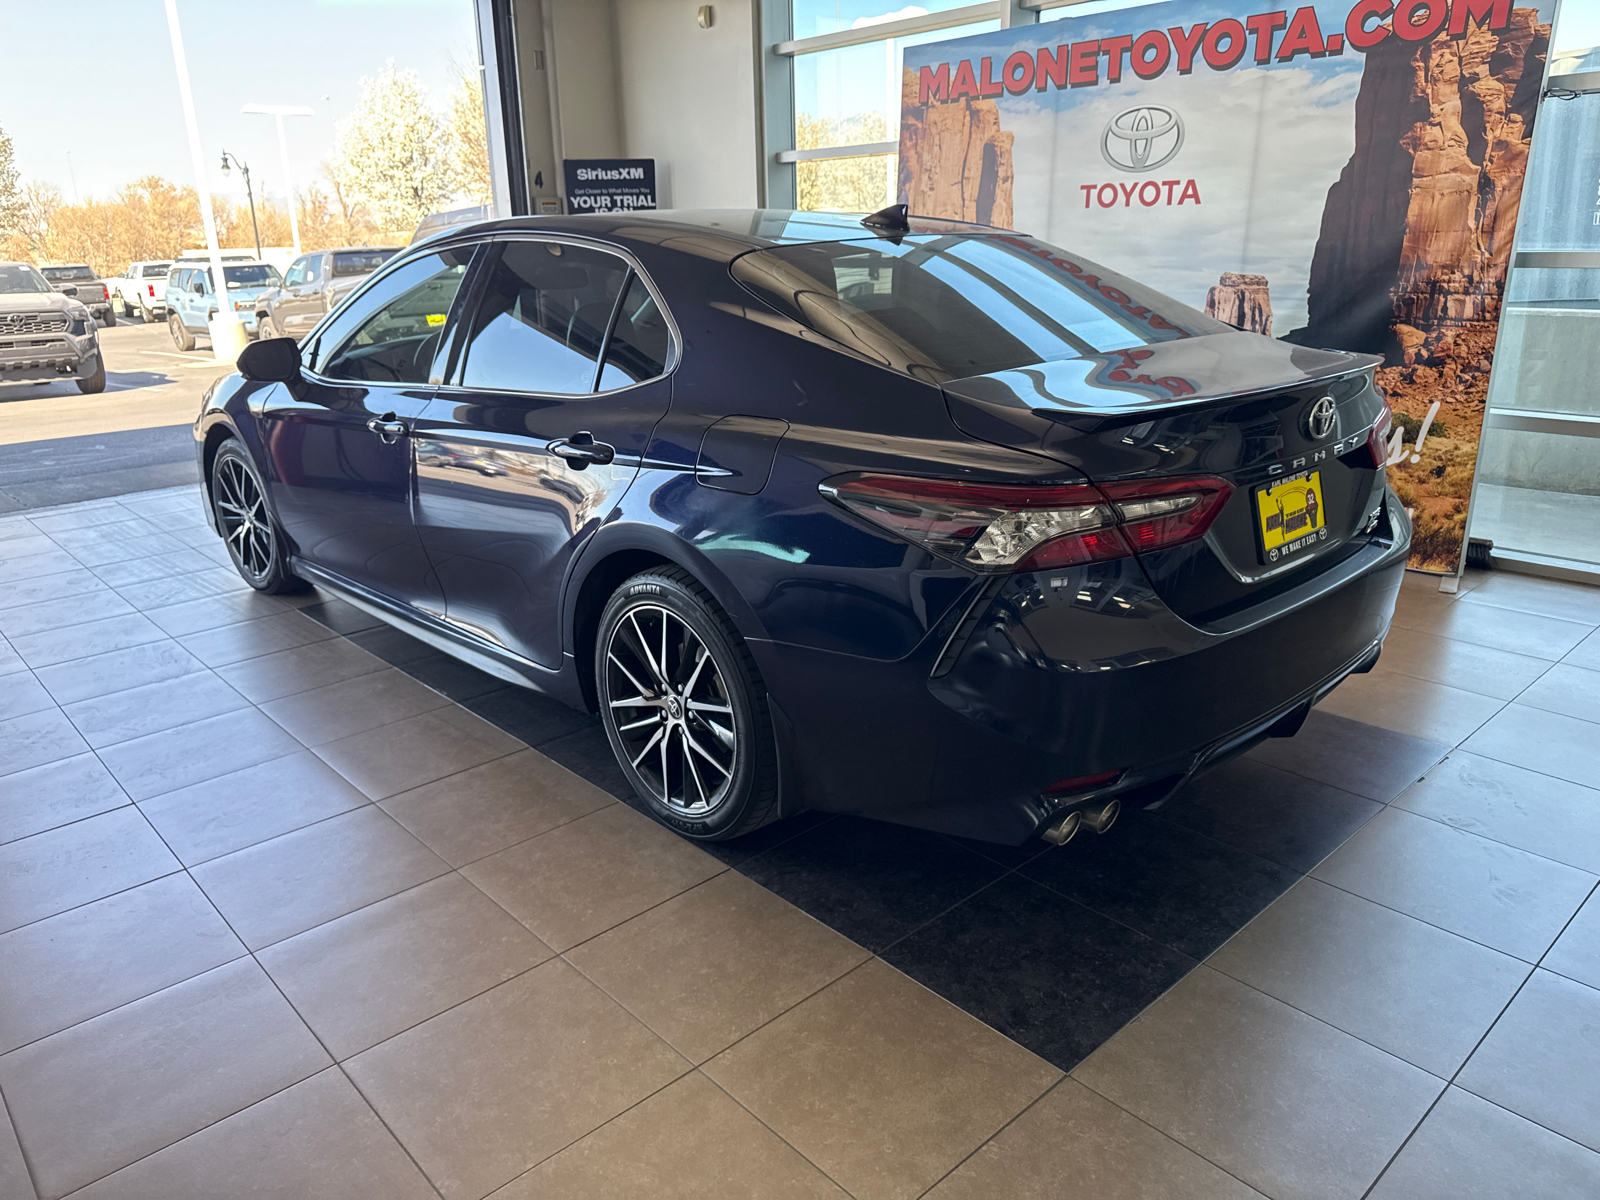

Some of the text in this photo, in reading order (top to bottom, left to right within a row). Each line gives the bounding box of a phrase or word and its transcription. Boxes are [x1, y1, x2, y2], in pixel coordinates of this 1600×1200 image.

[919, 0, 1515, 103] MALONETOYOTA.COM
[576, 167, 644, 181] SiriusXM
[570, 195, 611, 209] YOUR
[613, 195, 656, 207] TRIAL
[1080, 179, 1202, 209] TOYOTA
[1268, 436, 1359, 475] CAMRY
[1307, 493, 1315, 505] 32
[1281, 545, 1289, 555] WE
[1289, 539, 1301, 552] MAKE
[1306, 533, 1316, 545] EASY
[630, 584, 661, 595] ADVANTA
